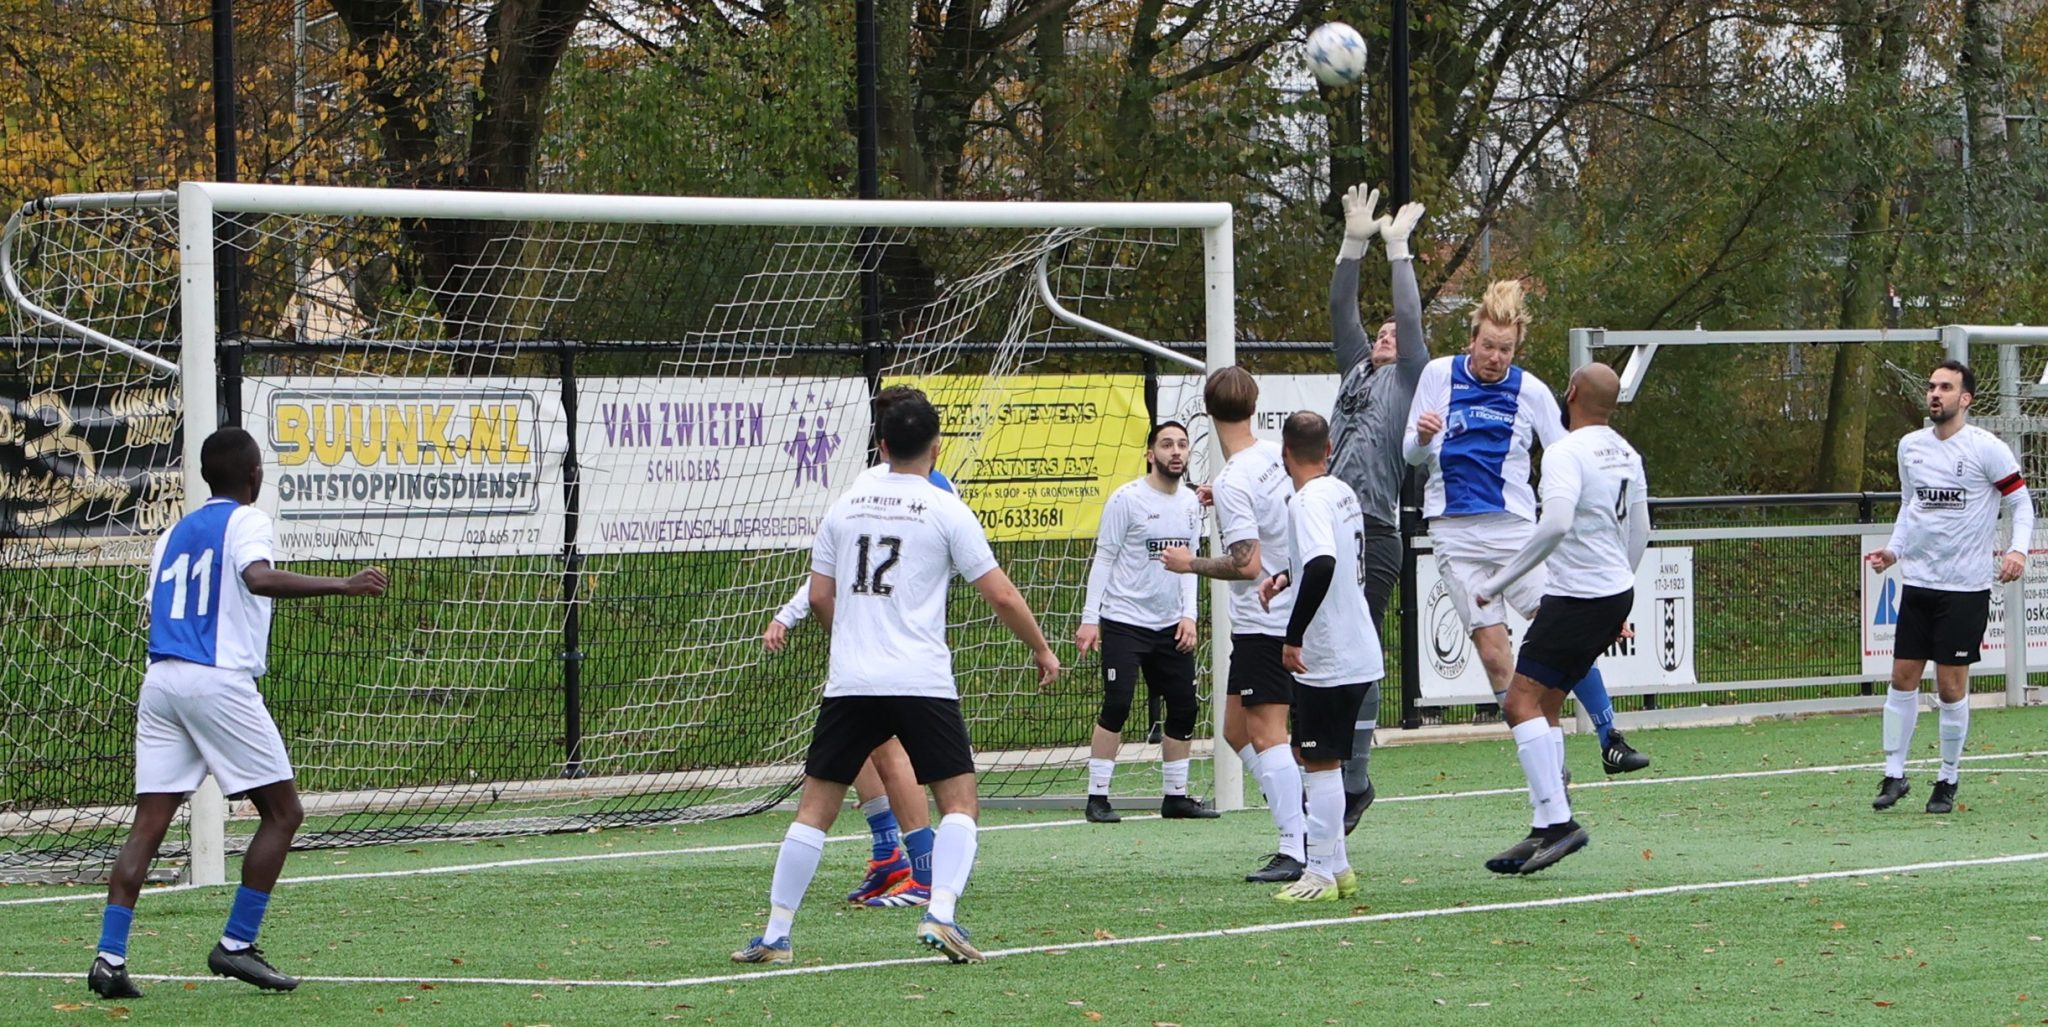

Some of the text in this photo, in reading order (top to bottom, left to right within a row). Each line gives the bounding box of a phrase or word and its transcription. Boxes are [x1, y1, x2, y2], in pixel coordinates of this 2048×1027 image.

[602, 402, 764, 448] VAN ZWIETEN
[998, 403, 1098, 425] STEVENS
[276, 404, 530, 466] BUUNK.NL
[648, 459, 720, 482] SCHILDERS
[974, 457, 1098, 477] PARTNERS B.V.
[278, 472, 531, 501] ONTSTOPPINGSDIENST
[995, 488, 1020, 499] SLOOP
[1041, 487, 1100, 498] GRONDWERKEN
[1615, 479, 1629, 523] 4
[974, 507, 1064, 528] 20-6333681
[280, 528, 540, 549] WWW.BUUNK.NL 020 665 77 27
[852, 534, 901, 596] 12
[1660, 564, 1679, 575] ANNO
[161, 548, 213, 619] 11
[1654, 578, 1685, 591] 17-3-1923
